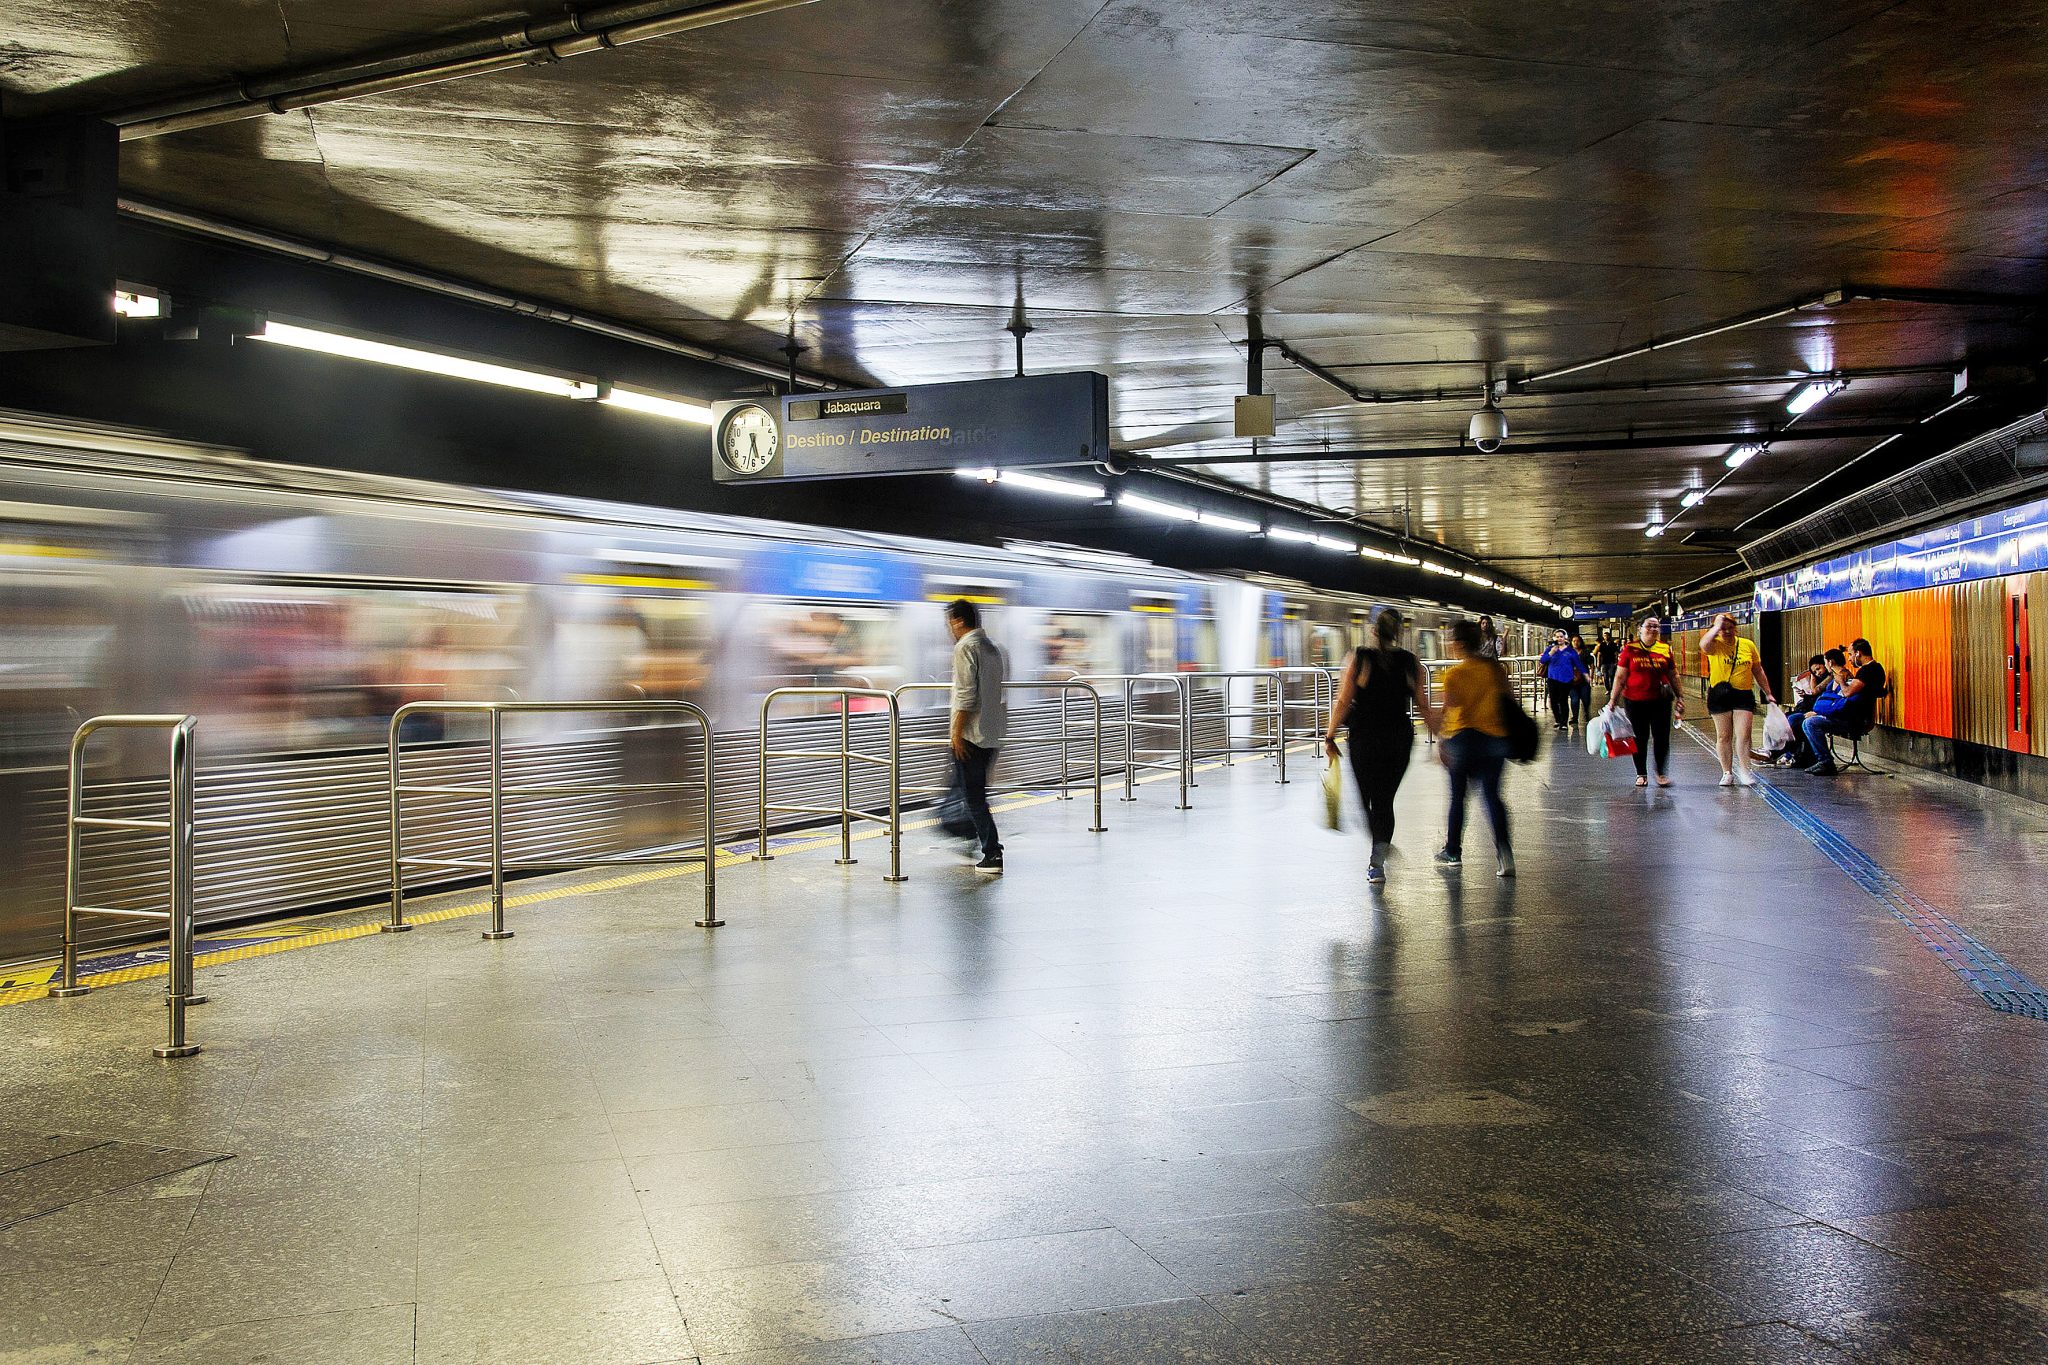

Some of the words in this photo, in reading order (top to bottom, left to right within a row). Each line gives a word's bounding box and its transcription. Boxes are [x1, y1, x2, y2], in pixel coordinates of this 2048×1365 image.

[824, 401, 881, 414] Jabaquara
[771, 435, 776, 445] 3
[786, 432, 845, 449] Destino
[860, 426, 950, 445] Destination
[730, 438, 736, 448] 9
[734, 449, 739, 459] 8
[767, 447, 773, 456] 4
[742, 456, 747, 465] 7
[751, 458, 756, 468] 6
[760, 455, 766, 465] 5
